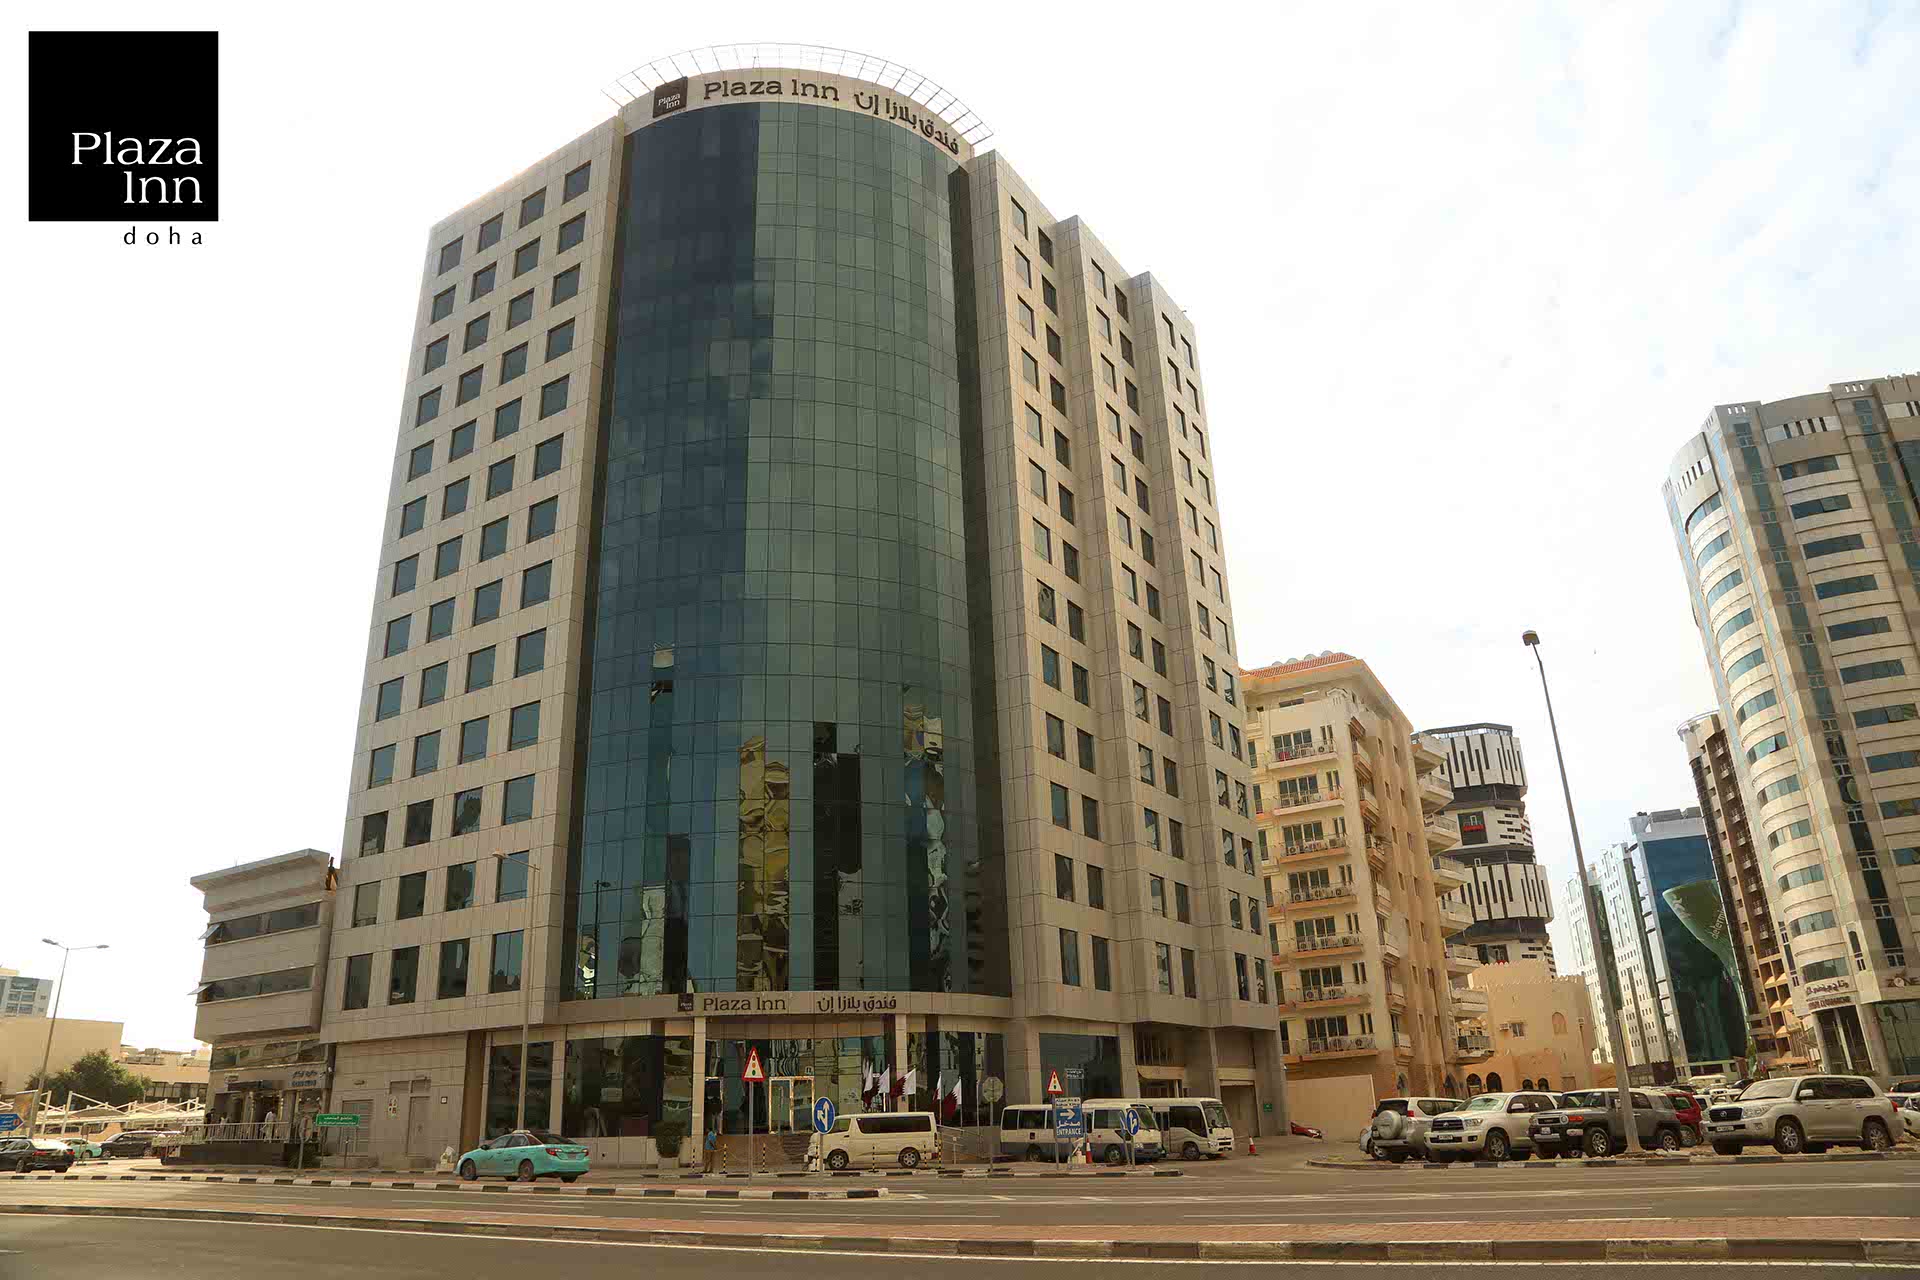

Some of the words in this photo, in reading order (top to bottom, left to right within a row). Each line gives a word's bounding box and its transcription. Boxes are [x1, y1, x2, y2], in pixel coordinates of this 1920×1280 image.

[657, 93, 681, 107] Plaza
[703, 79, 783, 100] Plaza
[791, 79, 840, 102] Inn
[853, 91, 879, 115] إن
[885, 97, 917, 130] بلازا
[918, 118, 960, 155] فندق
[703, 997, 751, 1011] Plaza
[756, 996, 787, 1011] Inn
[838, 996, 861, 1013] بلازا
[863, 996, 897, 1012] فندق
